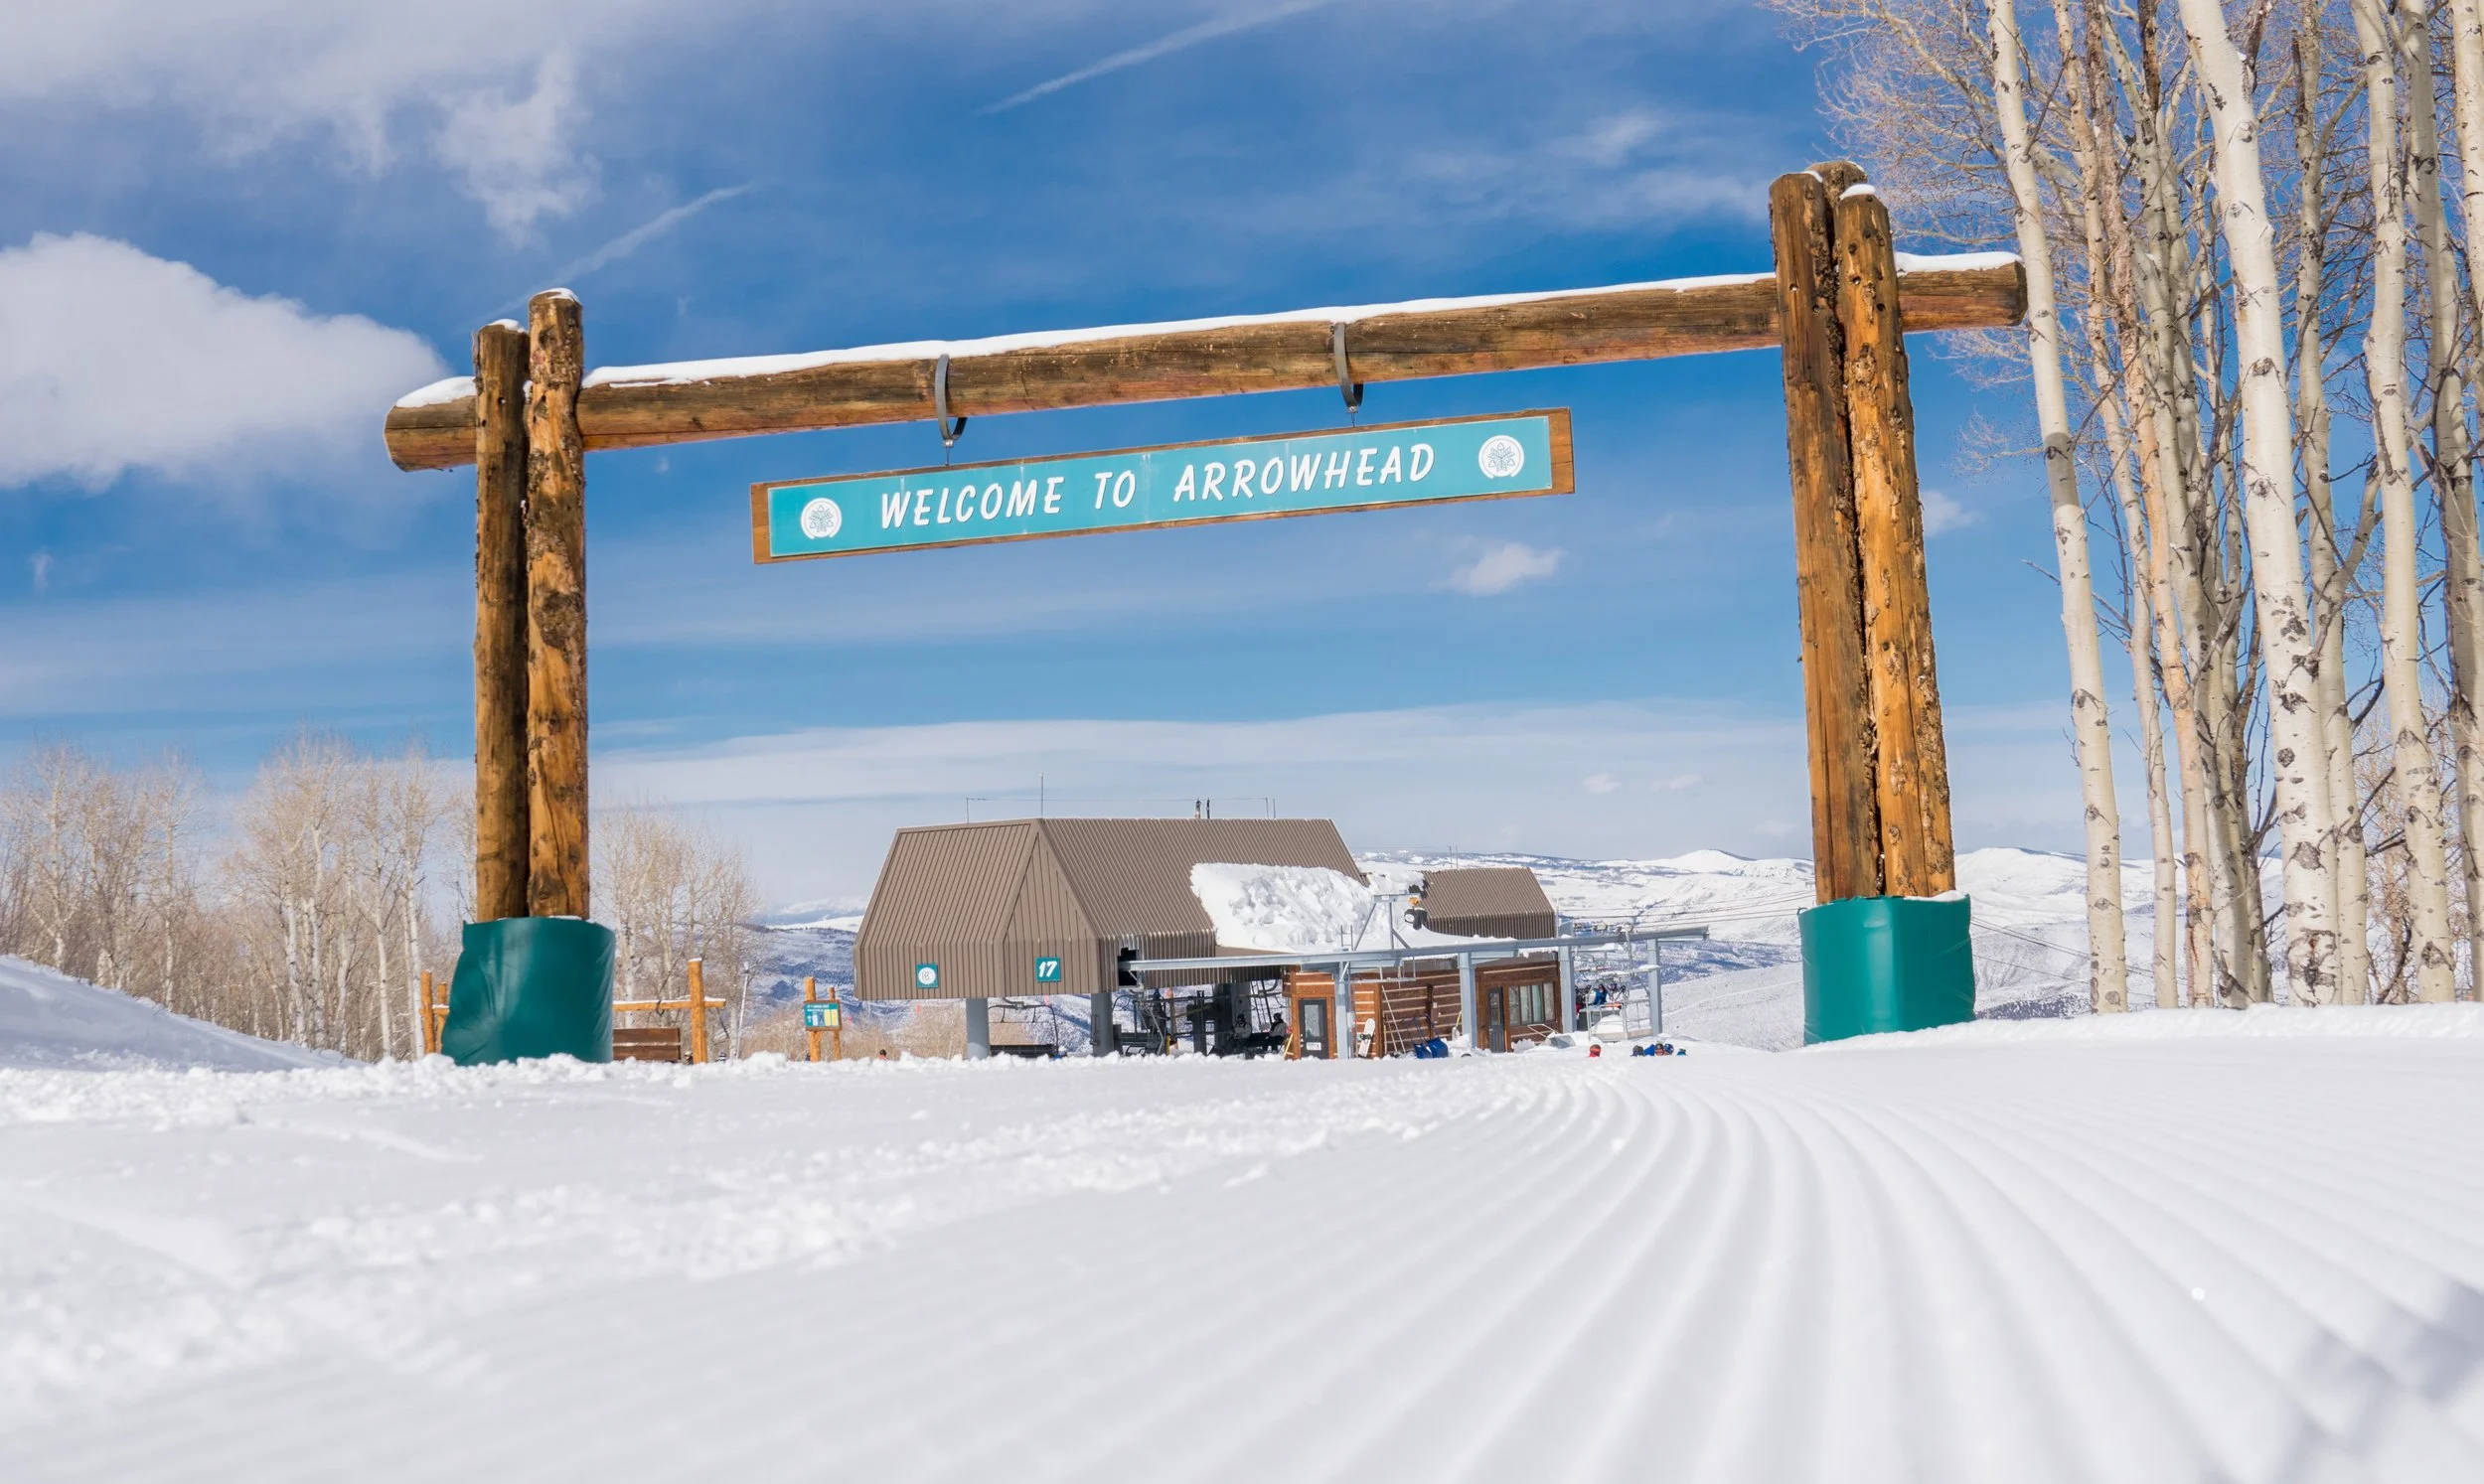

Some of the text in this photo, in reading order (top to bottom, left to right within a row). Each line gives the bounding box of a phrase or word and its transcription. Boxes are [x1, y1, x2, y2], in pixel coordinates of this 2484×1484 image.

[880, 443, 1436, 529] WELCOME TO ARROWHEAD
[1038, 961, 1058, 977] 17
